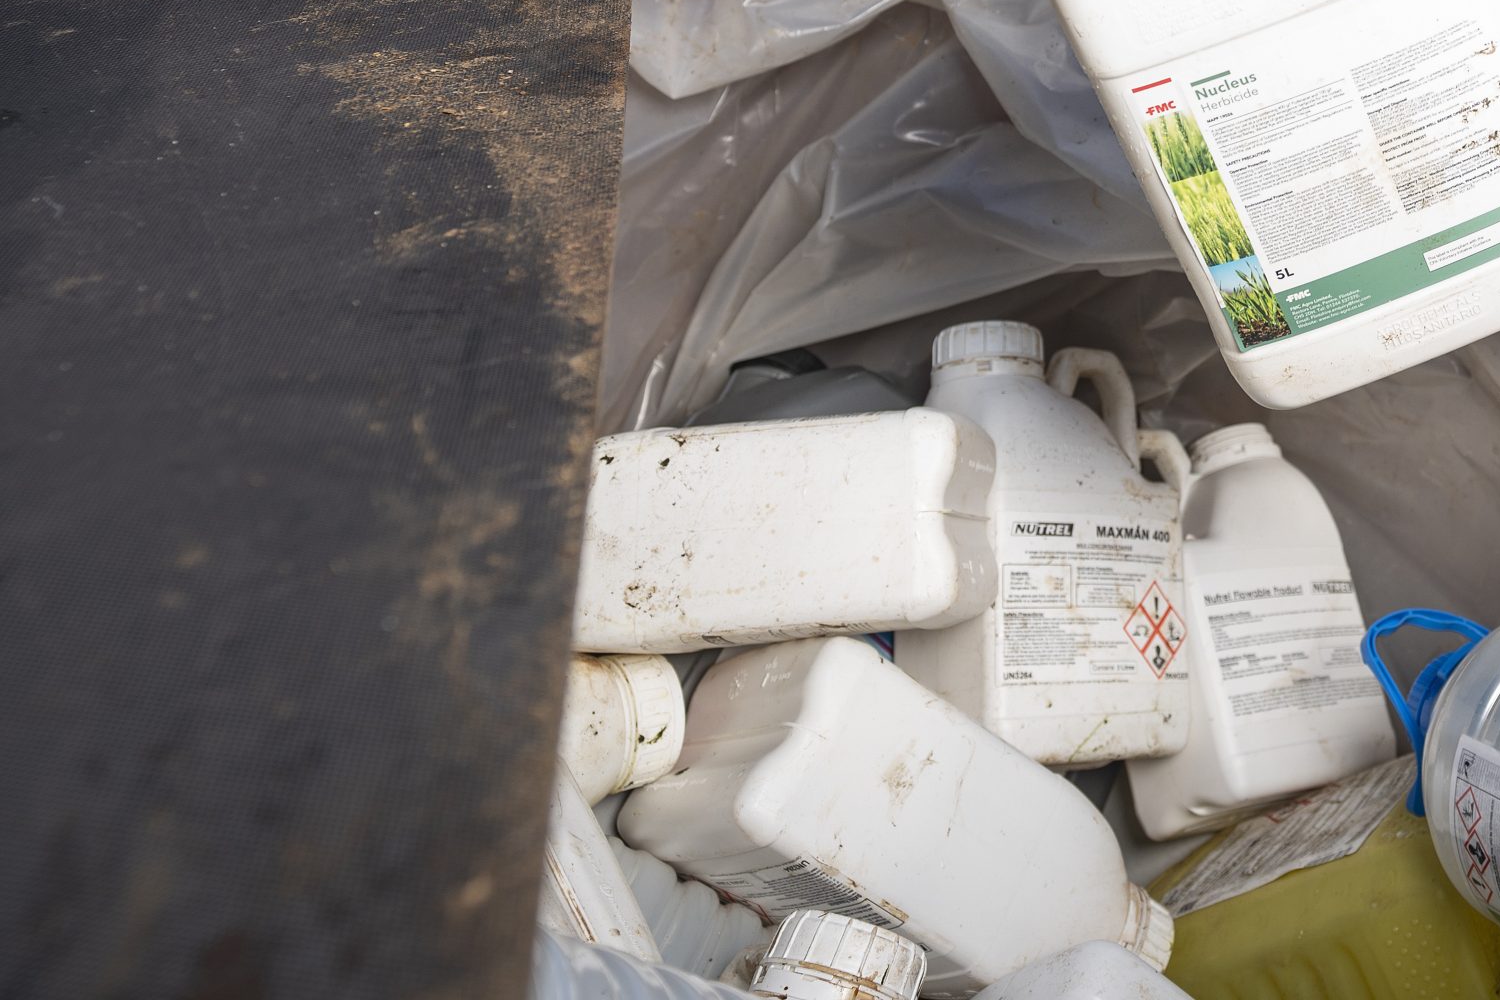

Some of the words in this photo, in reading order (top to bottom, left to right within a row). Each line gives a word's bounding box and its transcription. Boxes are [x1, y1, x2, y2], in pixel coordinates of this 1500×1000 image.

[1195, 74, 1256, 100] Nucleus
[1146, 101, 1176, 115] FMC
[1201, 88, 1258, 112] Herbicide
[1275, 268, 1294, 279] 5L
[1286, 289, 1311, 302] FMC
[1010, 520, 1074, 539] NUTREL
[1153, 531, 1170, 543] 400
[1203, 592, 1231, 605] Nutrel
[1273, 583, 1303, 597] Product
